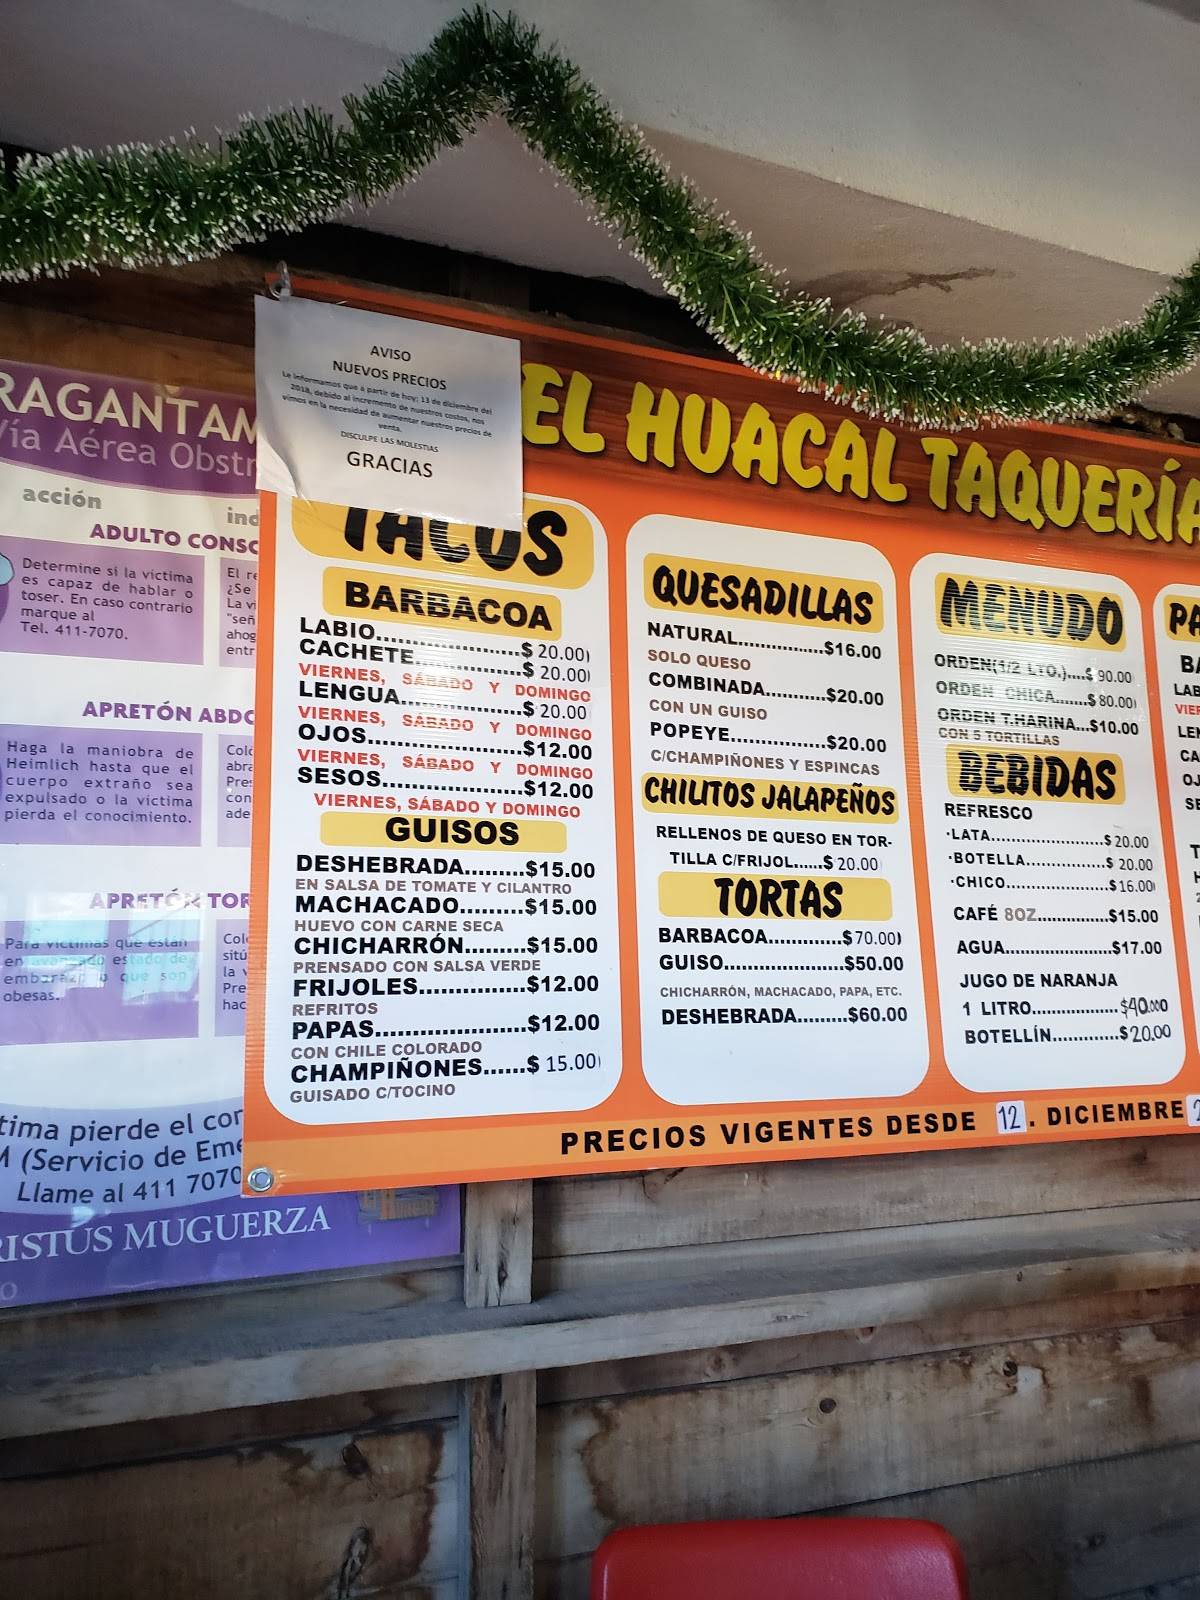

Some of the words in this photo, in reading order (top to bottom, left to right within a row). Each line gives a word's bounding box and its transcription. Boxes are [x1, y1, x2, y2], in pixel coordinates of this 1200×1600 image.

[370, 346, 411, 362] AVISO
[333, 360, 389, 379] NUEVOS
[392, 372, 447, 390] PRECIOS
[341, 430, 378, 442] DISCULPE
[381, 436, 395, 445] LAS
[397, 438, 438, 452] MOLESTIAS
[522, 363, 605, 453] EL
[626, 382, 908, 503] HUACAL
[54, 427, 157, 467] Aérea
[347, 451, 433, 478] GRACIAS
[23, 487, 102, 510] acción
[90, 523, 181, 547] ADULTO
[344, 506, 567, 577] TACOS
[23, 558, 101, 575] Determine
[124, 567, 137, 579] la
[22, 576, 39, 586] es
[48, 576, 93, 591] capaz
[102, 580, 120, 593] de
[129, 583, 177, 598] hablar
[652, 565, 873, 625] QUESADILLAS
[21, 591, 64, 604] toser.
[71, 594, 88, 606] En
[93, 597, 125, 609] caso
[129, 598, 193, 614] contrario
[345, 580, 552, 631] BARBACOA
[940, 577, 1123, 646] MENUDO
[21, 607, 77, 622] marque
[83, 610, 94, 622] al
[21, 622, 48, 634] Tel.
[54, 625, 128, 640] 411-7070.
[648, 650, 691, 664] SOLO
[697, 655, 751, 670] QUESO
[83, 701, 191, 722] APRETÓN
[649, 700, 684, 713] CON
[690, 703, 712, 715] UN
[719, 706, 767, 720] GUISO
[937, 707, 996, 724] ORDEN
[298, 706, 385, 727] VIERNES,
[402, 712, 473, 732] SÁBADO
[516, 723, 592, 741] DOMINGO
[938, 728, 968, 739] CON
[985, 729, 1060, 746] TORTILLAS
[7, 741, 47, 754] Haga
[88, 744, 164, 758] maniobra
[6, 758, 79, 772] Heimlich
[90, 761, 131, 772] hasta
[651, 749, 785, 770] C/CHAMPIÑONES
[805, 760, 880, 775] ESPINCAS
[6, 775, 68, 790] cuerpo
[958, 750, 1116, 800] BEBIDAS
[5, 792, 88, 807] expulsado
[315, 793, 402, 812] VIERNES,
[408, 796, 479, 813] SÁBADO
[486, 802, 496, 813] Y
[503, 803, 580, 818] DOMINGO
[645, 777, 755, 808] CHILITOS
[762, 782, 895, 815] JALAPEÑOS
[4, 809, 55, 822] pierda
[85, 811, 191, 824] conocimiento.
[945, 803, 1033, 820] REFRESCO
[385, 817, 520, 846] GUISOS
[656, 826, 742, 841] RELLENOS
[747, 830, 767, 842] DE
[773, 831, 826, 845] QUESO
[832, 834, 852, 845] EN
[857, 835, 892, 847] TOR-
[670, 852, 717, 866] TILLA
[295, 879, 318, 890] EN
[324, 879, 379, 892] SALSA
[385, 880, 406, 892] DE
[412, 880, 476, 893] TOMATE
[482, 882, 491, 893] Y
[497, 882, 572, 895] CILANTRO
[714, 877, 843, 919] TORTAS
[953, 904, 998, 921] CAFÉ
[294, 920, 354, 932] HUEVO
[361, 920, 396, 932] CON
[402, 920, 457, 932] CARNE
[463, 920, 504, 932] SECA
[293, 961, 387, 974] PRENSADO
[393, 961, 428, 972] CON
[434, 960, 485, 972] SALSA
[490, 960, 541, 971] VERDE
[960, 973, 1007, 988] JUGO
[1013, 974, 1035, 987] DE
[1041, 972, 1118, 987] NARANJA
[660, 984, 750, 998] CHICHARRÓN,
[754, 986, 836, 998] MACHACADO,
[840, 986, 872, 997] PAPA,
[876, 986, 902, 996] ETC.
[292, 1003, 378, 1016] REFRITOS
[291, 1047, 328, 1059] CON
[335, 1044, 386, 1058] CHILE
[392, 1041, 482, 1056] COLORADO
[290, 1088, 370, 1103] GUISADO
[376, 1084, 456, 1099] C/TOCINO
[69, 1118, 160, 1147] pierde
[170, 1113, 193, 1135] el
[561, 1124, 706, 1155] PRECIOS
[721, 1116, 873, 1146] VIGENTES
[887, 1111, 976, 1137] DESDE
[999, 1105, 1021, 1130] 12
[1047, 1100, 1184, 1126] DICIEMBRE
[22, 1148, 144, 1175] (Servicio
[155, 1145, 186, 1168] de
[17, 1182, 94, 1204] Llame
[103, 1183, 123, 1202] al
[133, 1177, 175, 1201] 411
[187, 1166, 241, 1194] 7070
[123, 1204, 331, 1251] MUGUERZA
